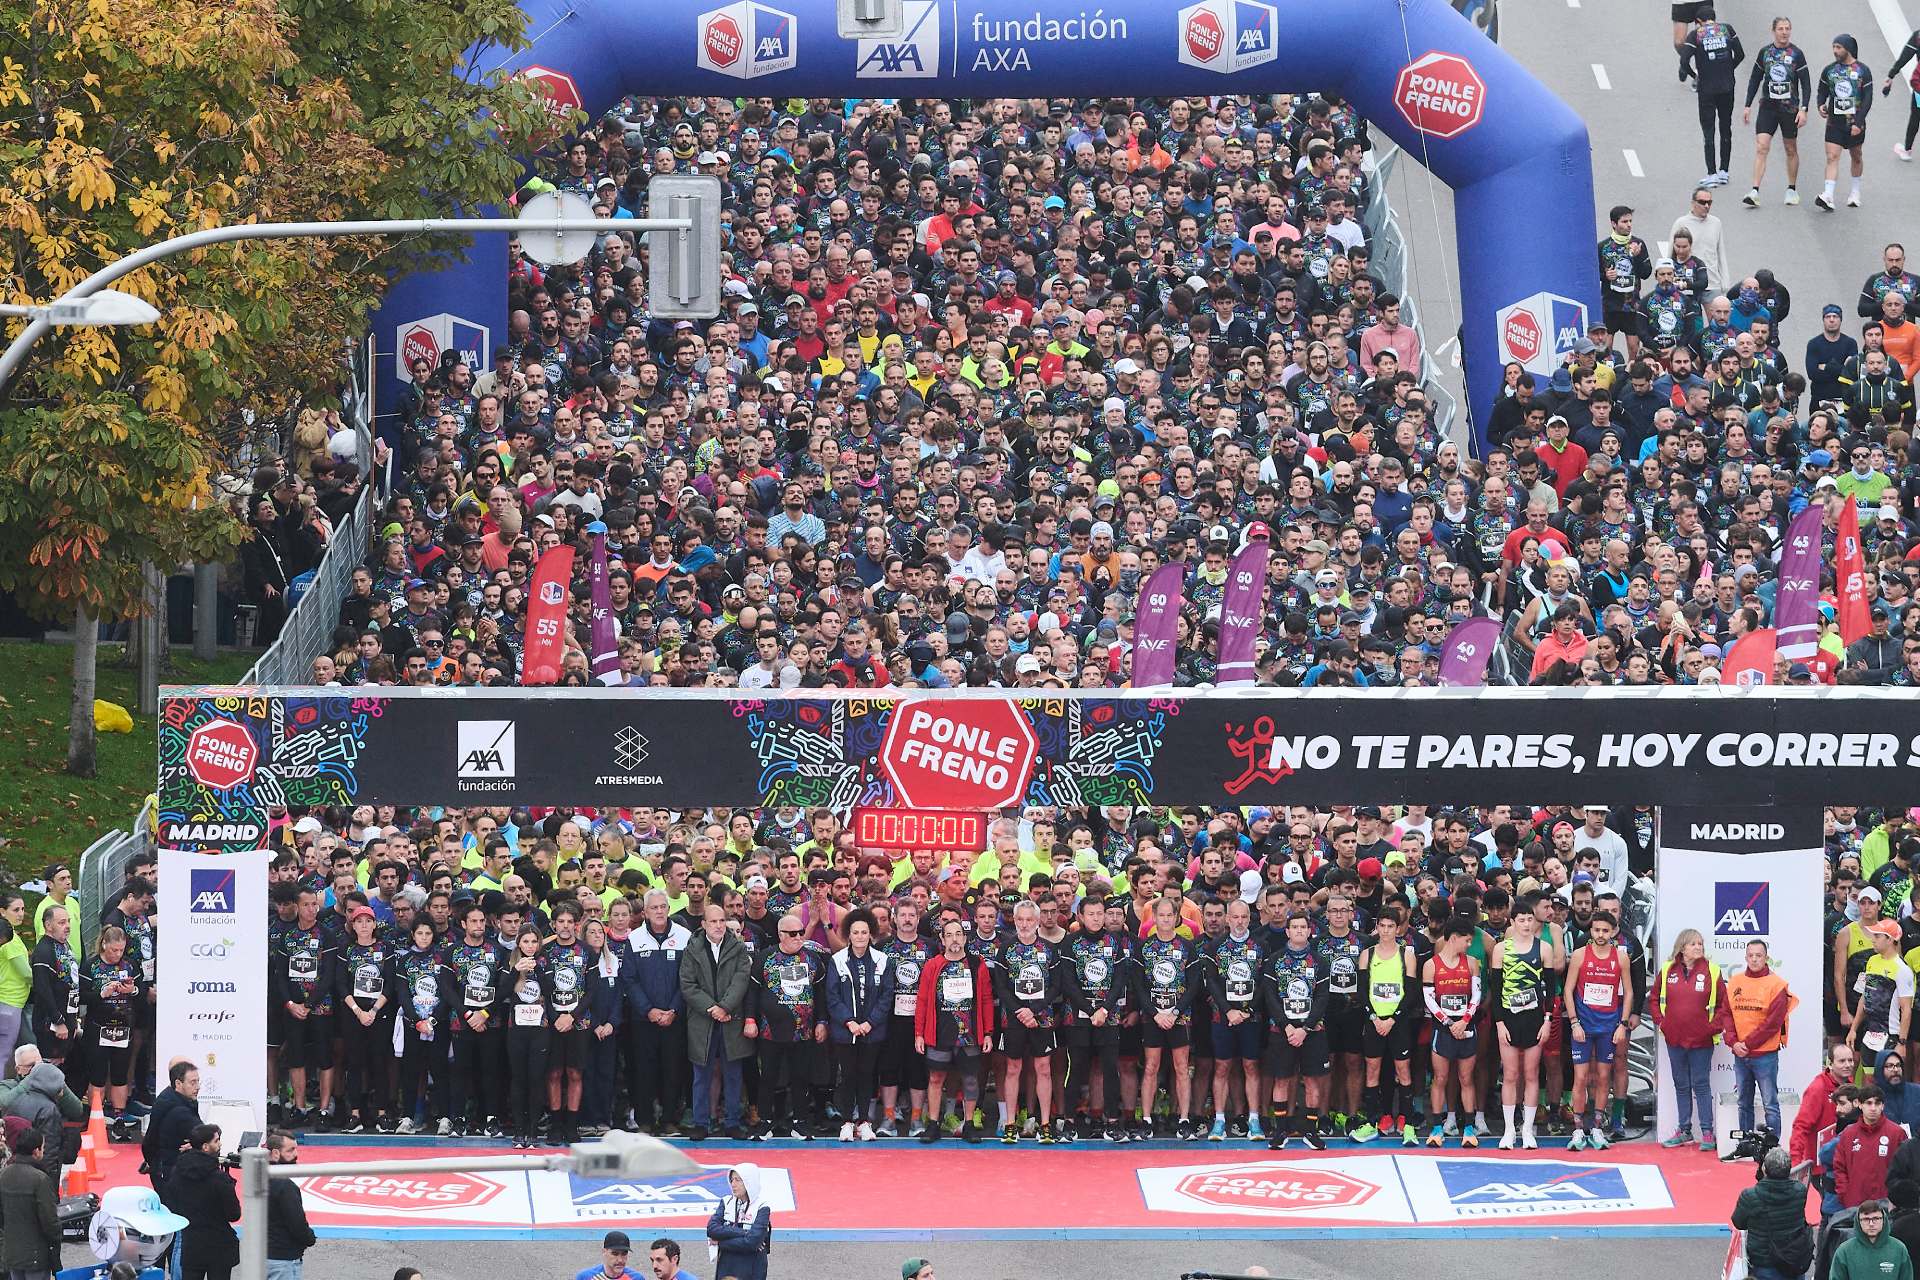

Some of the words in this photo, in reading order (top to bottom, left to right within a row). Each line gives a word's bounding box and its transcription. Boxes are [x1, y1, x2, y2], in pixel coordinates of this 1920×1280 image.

[972, 9, 1128, 42] fundación
[1191, 22, 1219, 41] PONLE
[710, 26, 738, 48] PONLE
[1189, 33, 1217, 52] FRENO
[1236, 29, 1266, 51] AXA
[708, 37, 734, 58] FRENO
[755, 37, 783, 58] AXA
[857, 43, 924, 72] AXA
[972, 47, 1032, 72] AXA
[754, 60, 790, 74] fundación
[1409, 74, 1475, 101] PONLE
[1405, 90, 1471, 117] FRENO
[1508, 321, 1537, 341] PONLE
[407, 338, 435, 360] PONLE
[1507, 331, 1535, 351] FRENO
[1237, 572, 1253, 584] 60
[1783, 580, 1814, 592] AVE
[1150, 594, 1166, 606] 60
[537, 618, 558, 636] 55
[1224, 616, 1255, 629] AVE
[1138, 639, 1170, 650] AVE
[909, 710, 1019, 763] PONLE
[198, 735, 250, 759] PONLE
[1268, 735, 1341, 769] NO
[1351, 735, 1410, 769] TE
[1416, 734, 1586, 774] PARES,
[1597, 733, 1702, 768] HOY
[1706, 732, 1900, 768] CORRER
[194, 750, 245, 773] FRENO
[458, 750, 504, 771] AXA
[900, 739, 1009, 790] FRENO
[458, 778, 516, 791] fundación
[595, 776, 663, 785] ATRESMEDIA
[168, 824, 259, 841] MADRID
[1691, 823, 1785, 841] MADRID
[191, 891, 228, 909] AXA
[190, 915, 236, 925] fundación
[1714, 909, 1760, 932] AXA
[189, 1010, 235, 1024] renfe
[321, 1183, 459, 1200] FRENO
[329, 1175, 472, 1193] PONLE
[573, 1184, 722, 1201] AXA
[1198, 1185, 1337, 1201] FRENO
[1203, 1176, 1346, 1194] PONLE
[1449, 1182, 1600, 1200] AXA
[1456, 1200, 1635, 1215] fundación
